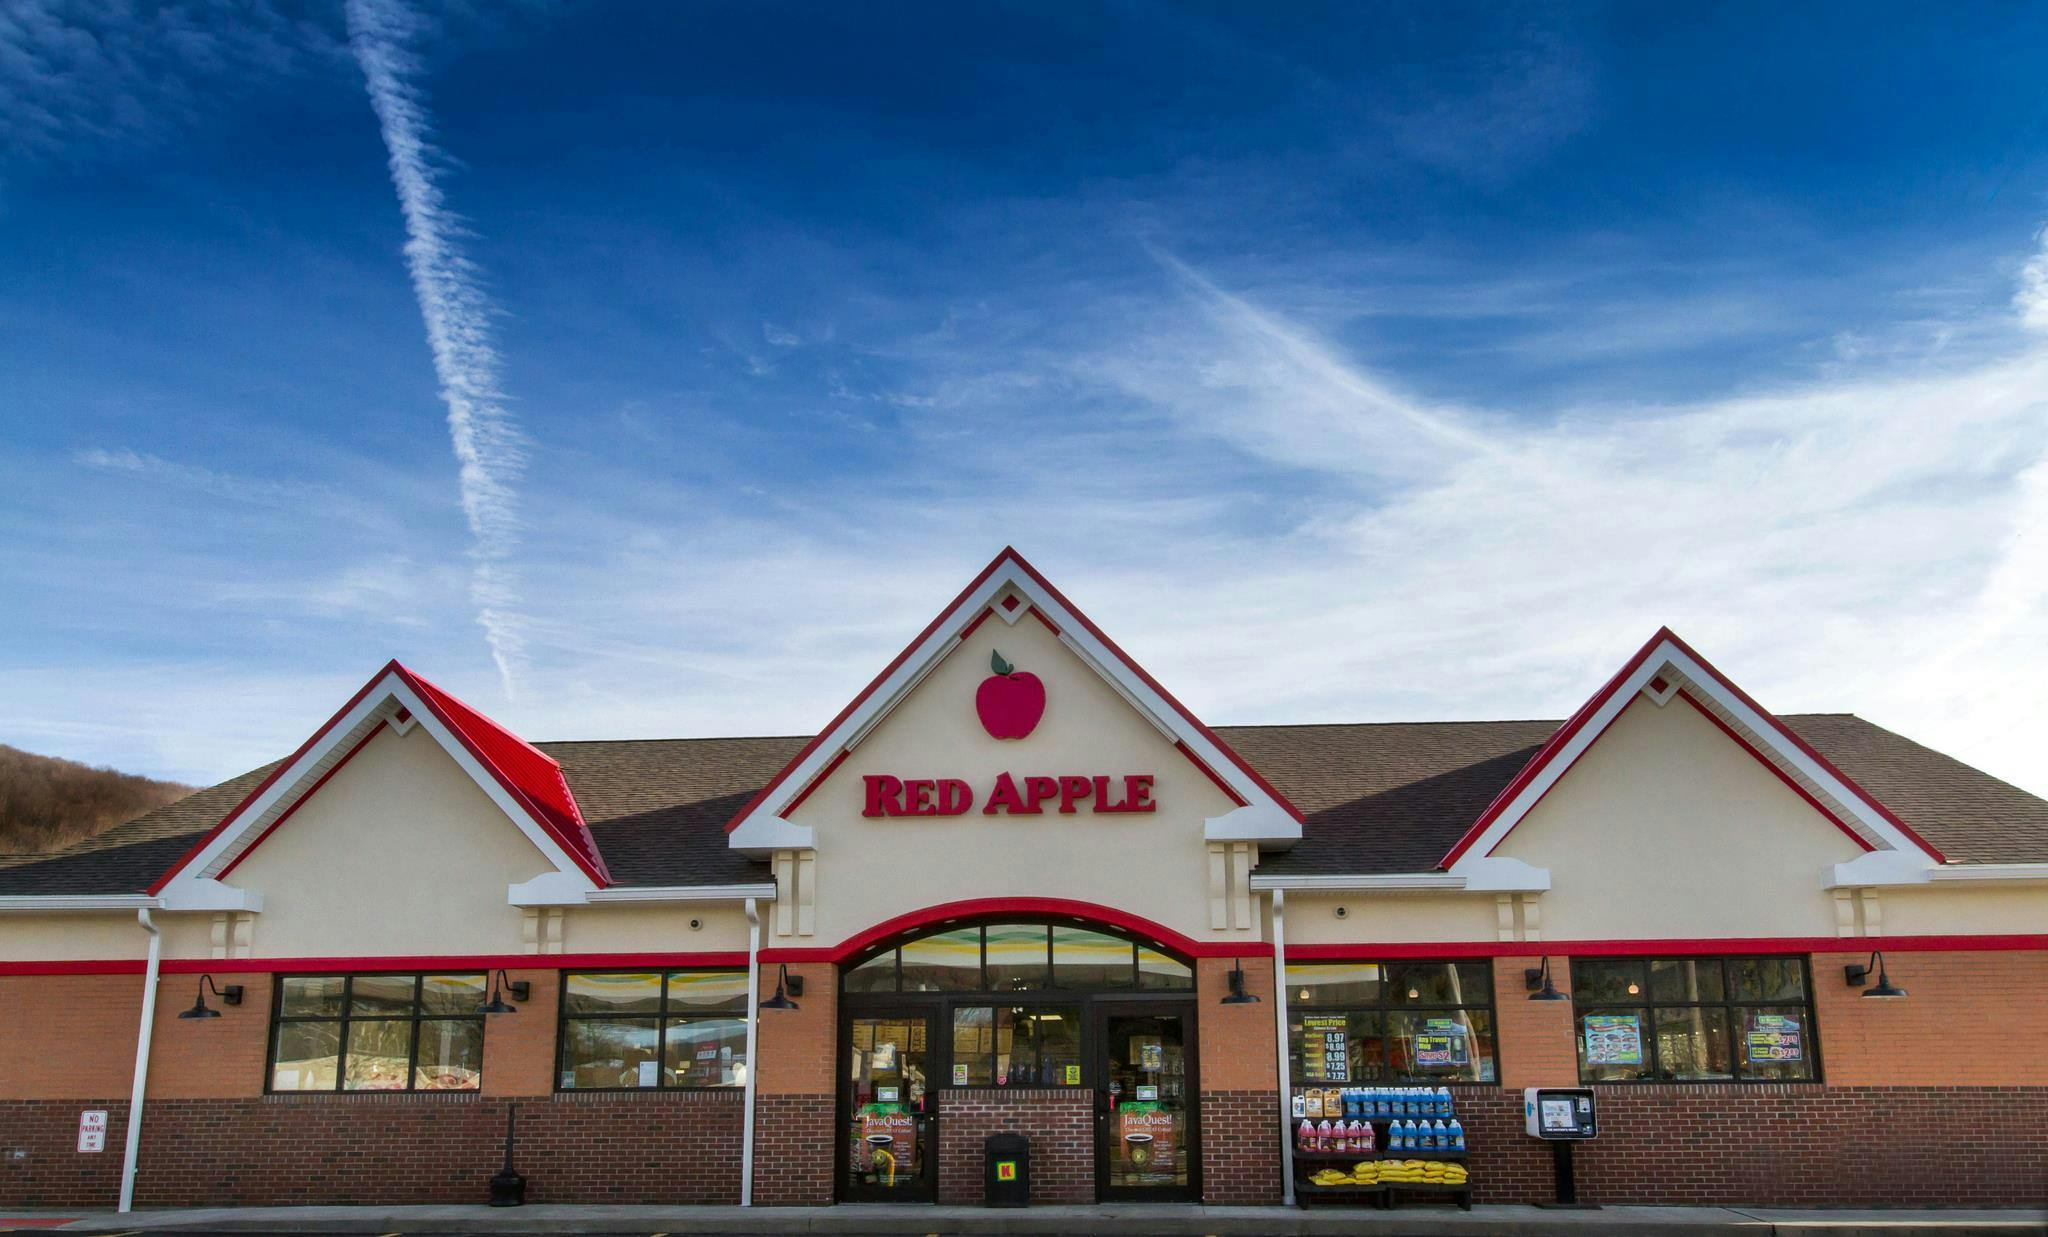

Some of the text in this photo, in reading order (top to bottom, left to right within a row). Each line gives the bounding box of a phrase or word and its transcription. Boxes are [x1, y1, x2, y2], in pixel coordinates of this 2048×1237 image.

[862, 771, 1157, 817] RED APPLE
[1326, 1033, 1345, 1043] 8.97
[1326, 1051, 1345, 1061] 8.99
[90, 1115, 99, 1123] NO
[866, 1115, 913, 1128] JavaQuest!
[1124, 1114, 1173, 1128] JavaQuest!
